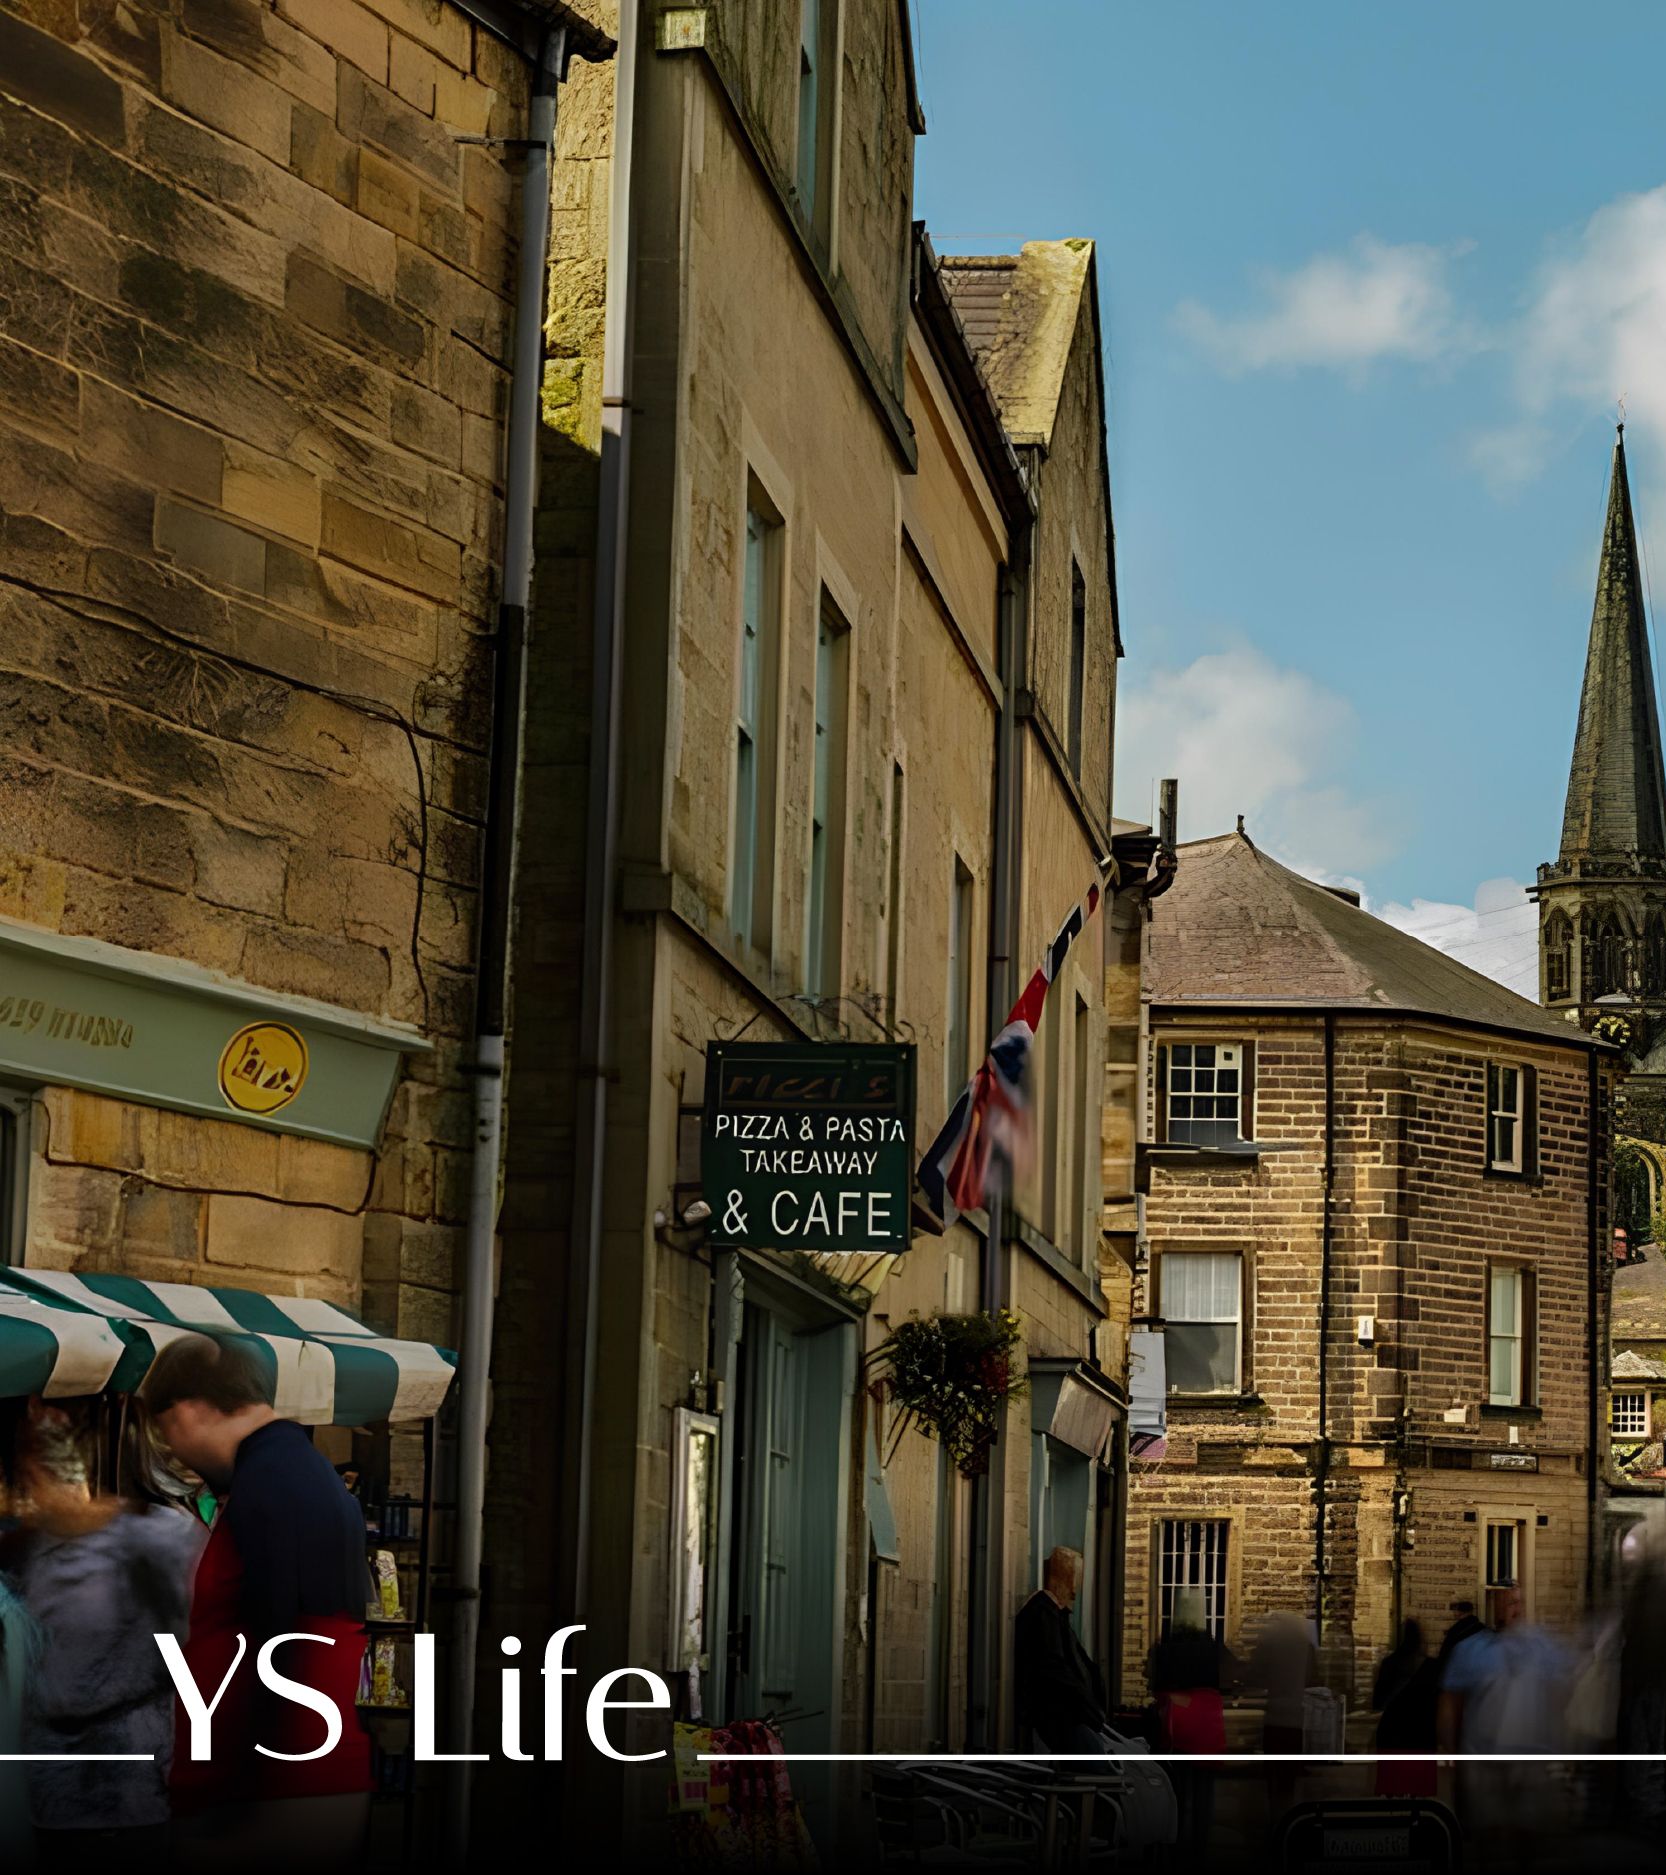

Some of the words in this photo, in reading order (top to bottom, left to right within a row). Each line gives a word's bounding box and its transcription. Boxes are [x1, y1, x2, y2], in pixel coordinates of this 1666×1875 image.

[715, 1114, 790, 1140] PIZZA
[799, 1115, 814, 1141] &
[826, 1116, 906, 1142] PASTA
[739, 1149, 878, 1175] TAKEAWAY
[722, 1188, 749, 1235] &
[771, 1190, 892, 1237] CAFE
